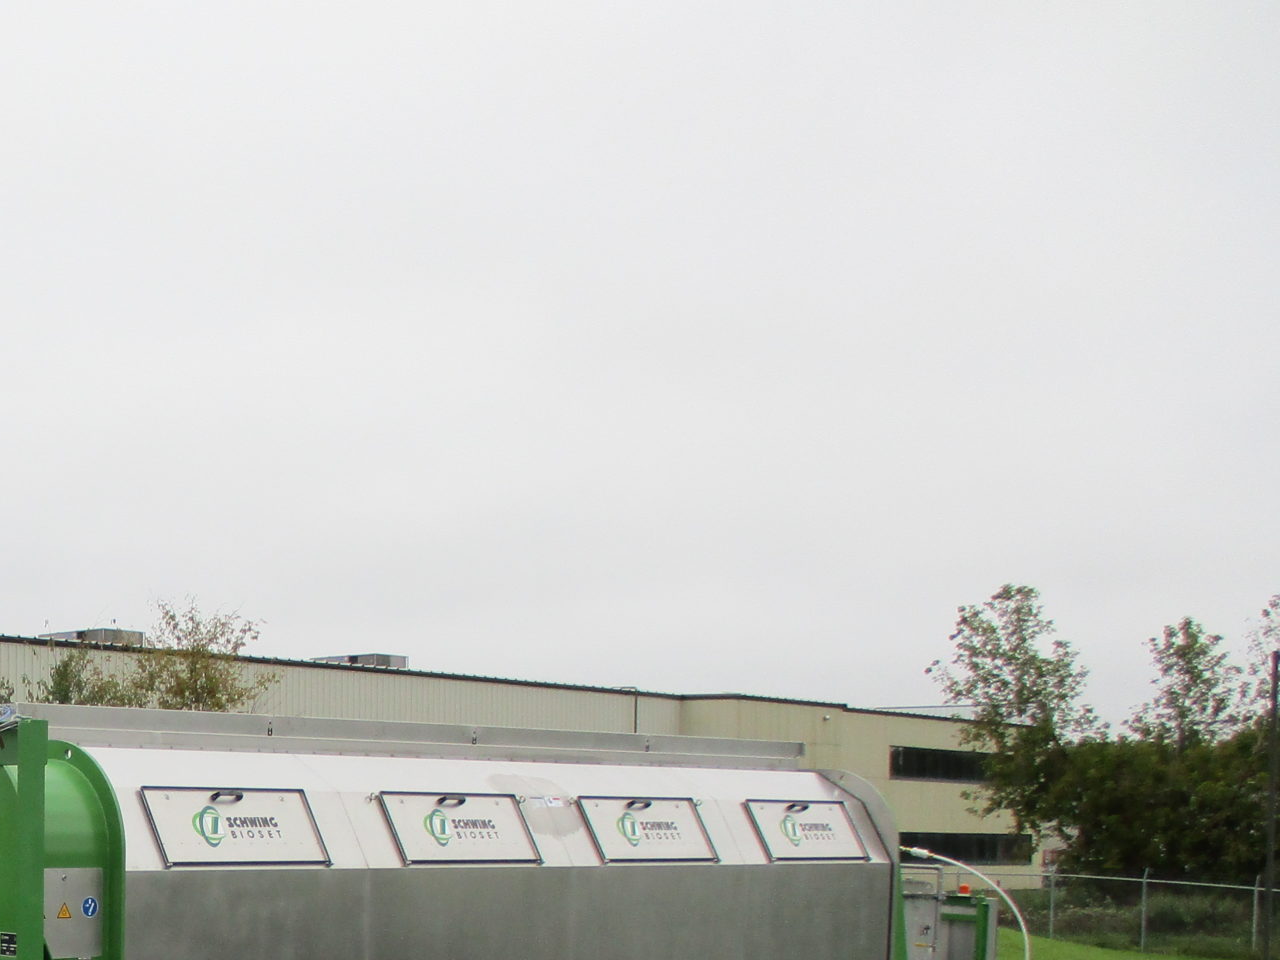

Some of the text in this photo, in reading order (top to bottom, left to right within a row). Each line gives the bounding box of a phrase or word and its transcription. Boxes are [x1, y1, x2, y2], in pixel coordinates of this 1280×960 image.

[226, 816, 278, 828] SCHWING
[451, 818, 496, 830] SCHWING
[231, 829, 283, 840] BIOSET
[456, 831, 500, 840] BIOSET
